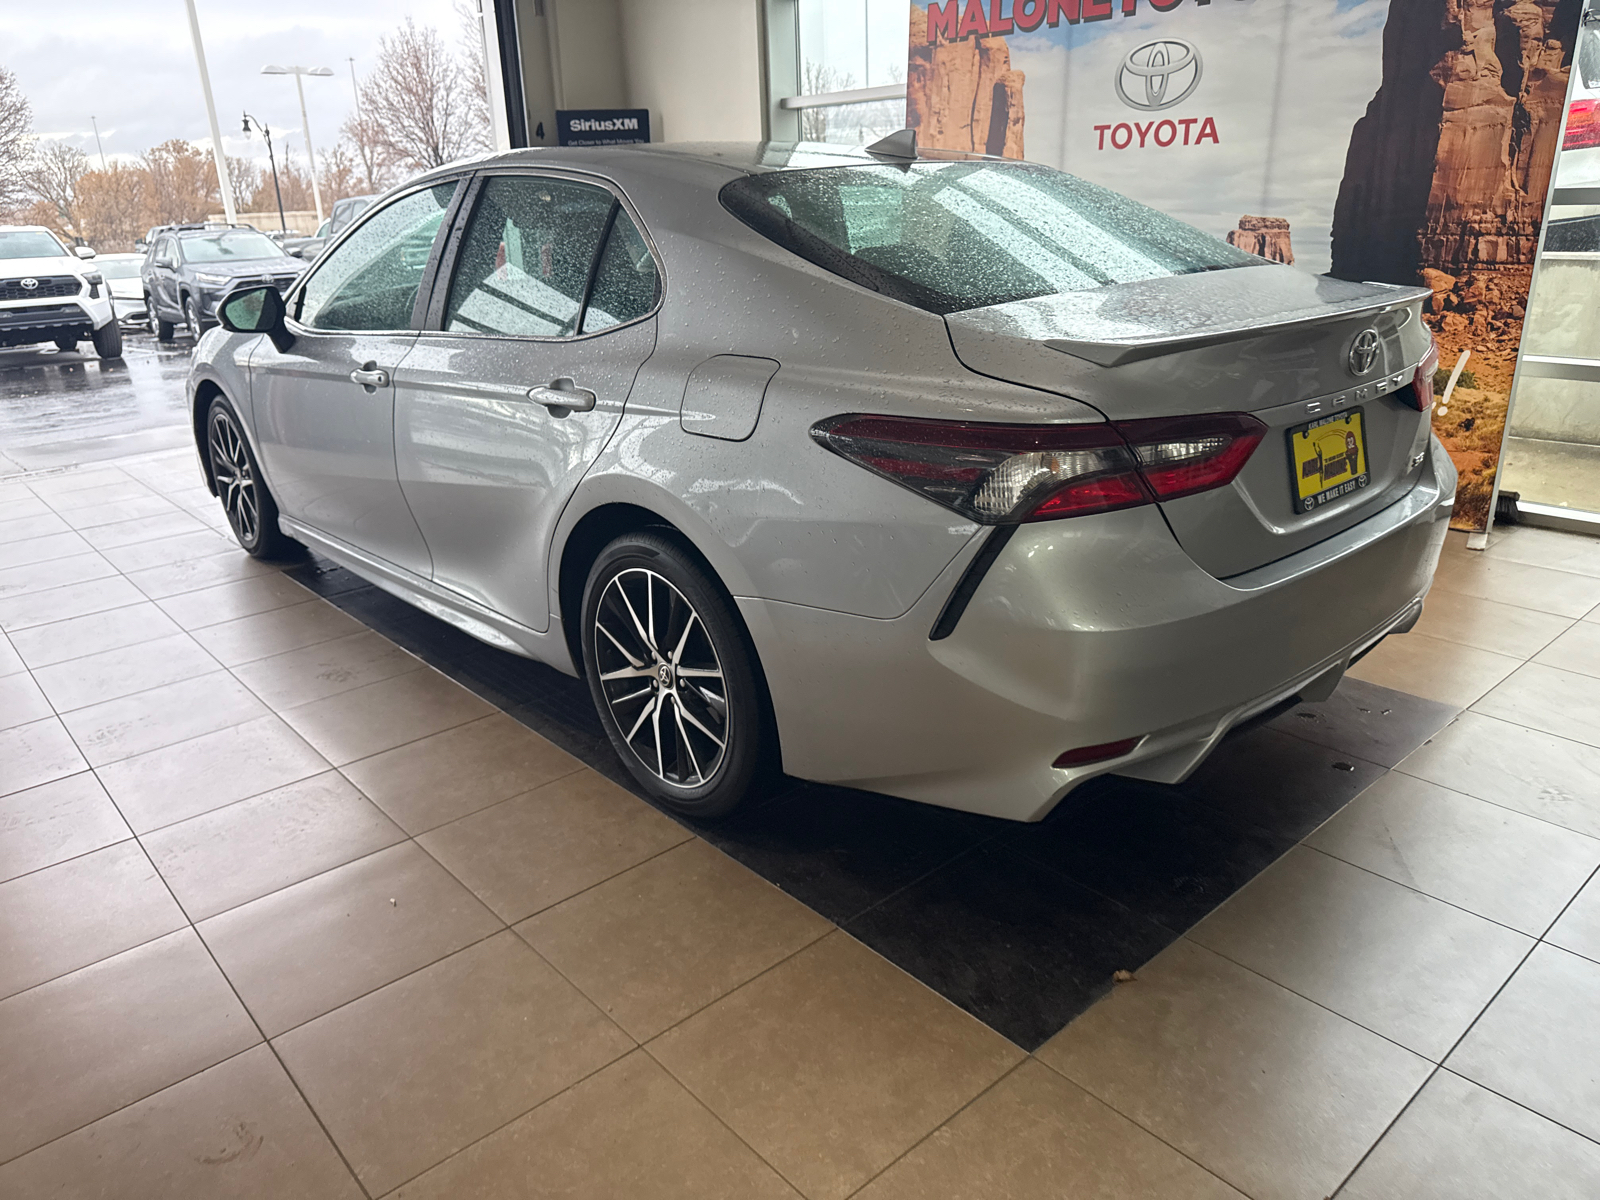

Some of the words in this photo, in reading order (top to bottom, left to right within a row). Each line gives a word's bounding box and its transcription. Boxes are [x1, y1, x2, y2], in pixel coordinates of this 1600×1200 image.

[569, 118, 639, 132] SiriusXM
[1093, 117, 1220, 150] TOYOTA
[1305, 374, 1403, 414] CAMRY
[1346, 436, 1356, 449] 32
[1317, 493, 1326, 504] WE
[1325, 487, 1339, 501] MAKE
[1344, 480, 1356, 493] EASY
